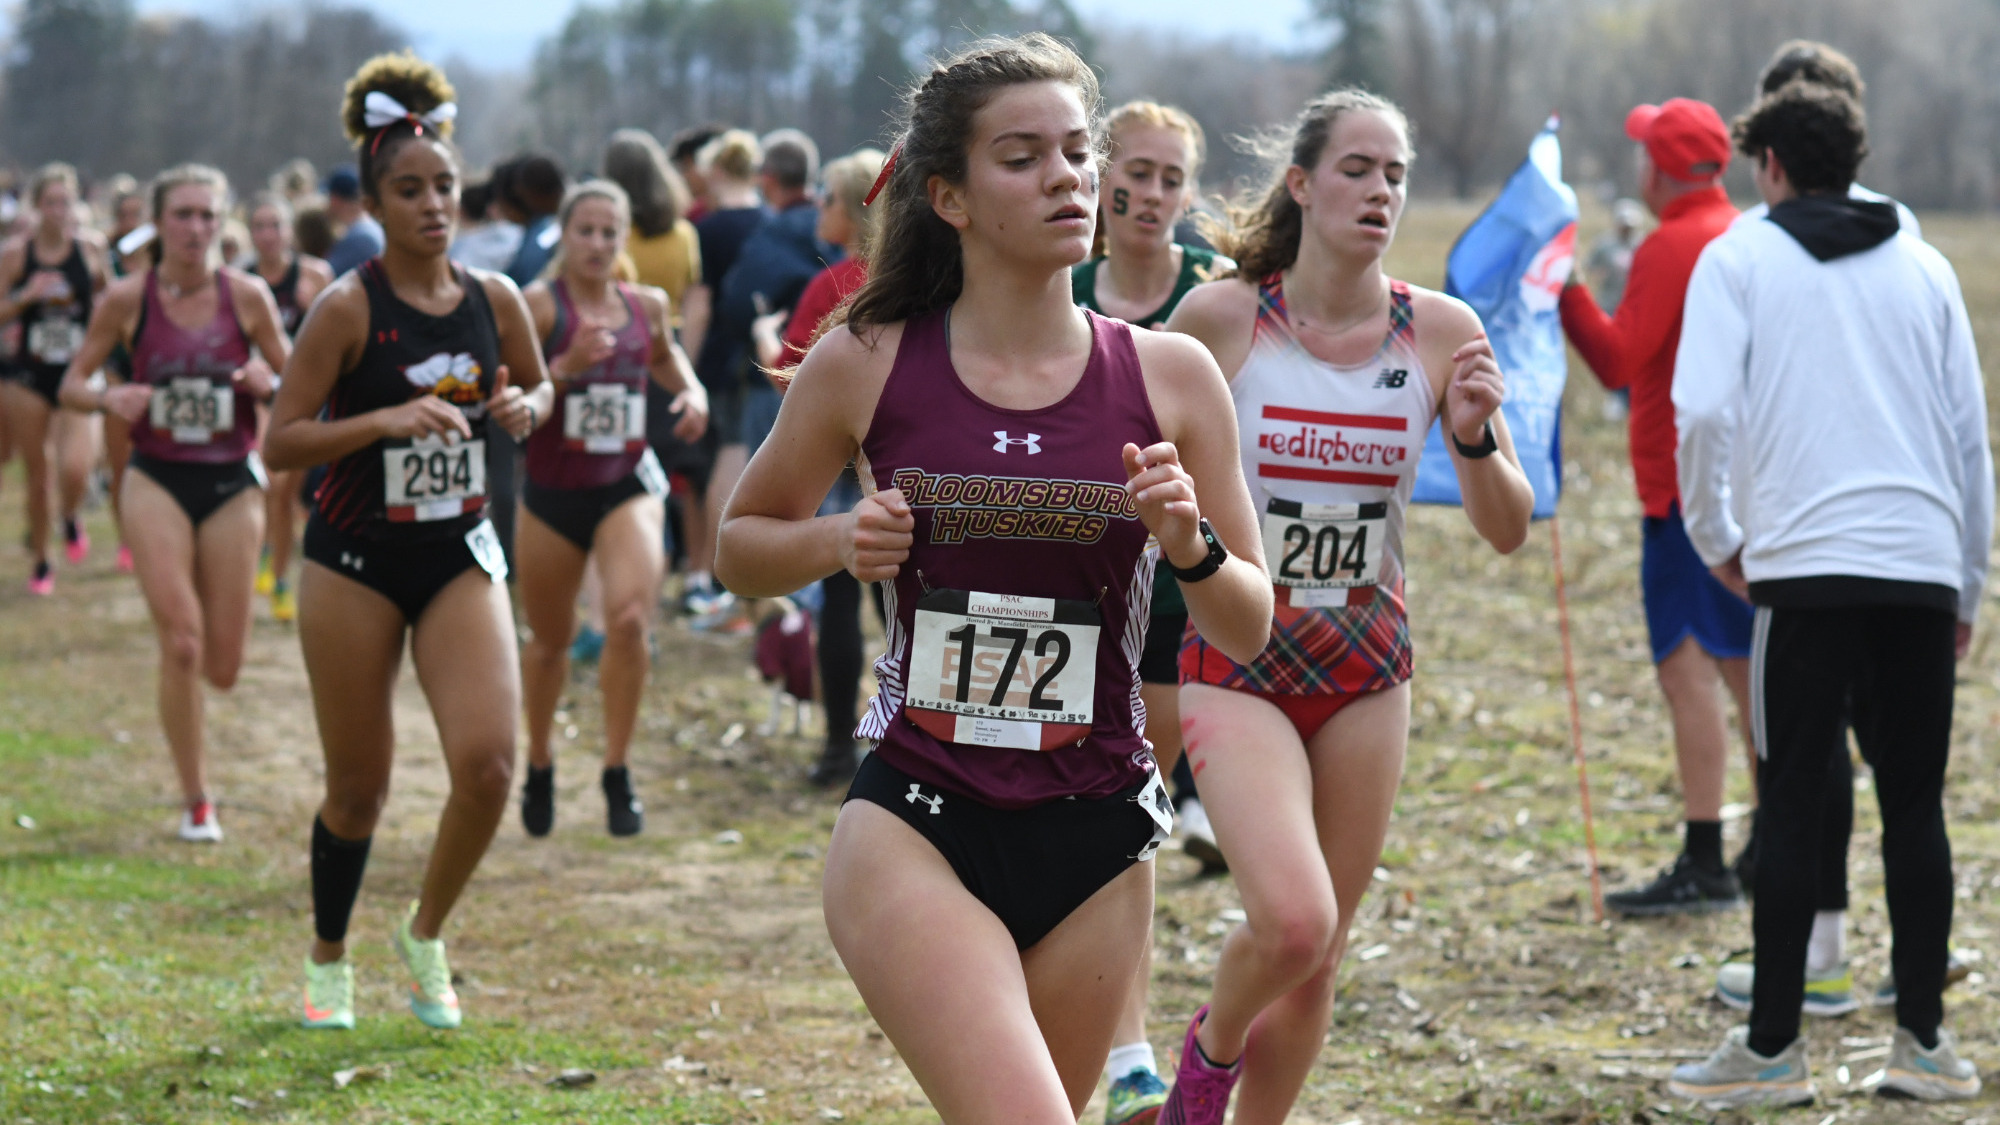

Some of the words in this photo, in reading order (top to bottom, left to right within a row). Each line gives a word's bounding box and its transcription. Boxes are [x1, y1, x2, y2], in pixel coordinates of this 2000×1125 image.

[1112, 187, 1130, 216] S
[165, 391, 218, 427] 239
[579, 399, 629, 434] 251
[403, 448, 472, 498] 294
[930, 507, 1108, 544] HUSKIES
[1279, 523, 1368, 580] 204
[971, 605, 1049, 618] CHAMPIONSHIPS
[999, 594, 1023, 604] PSAC
[948, 623, 1071, 711] 172
